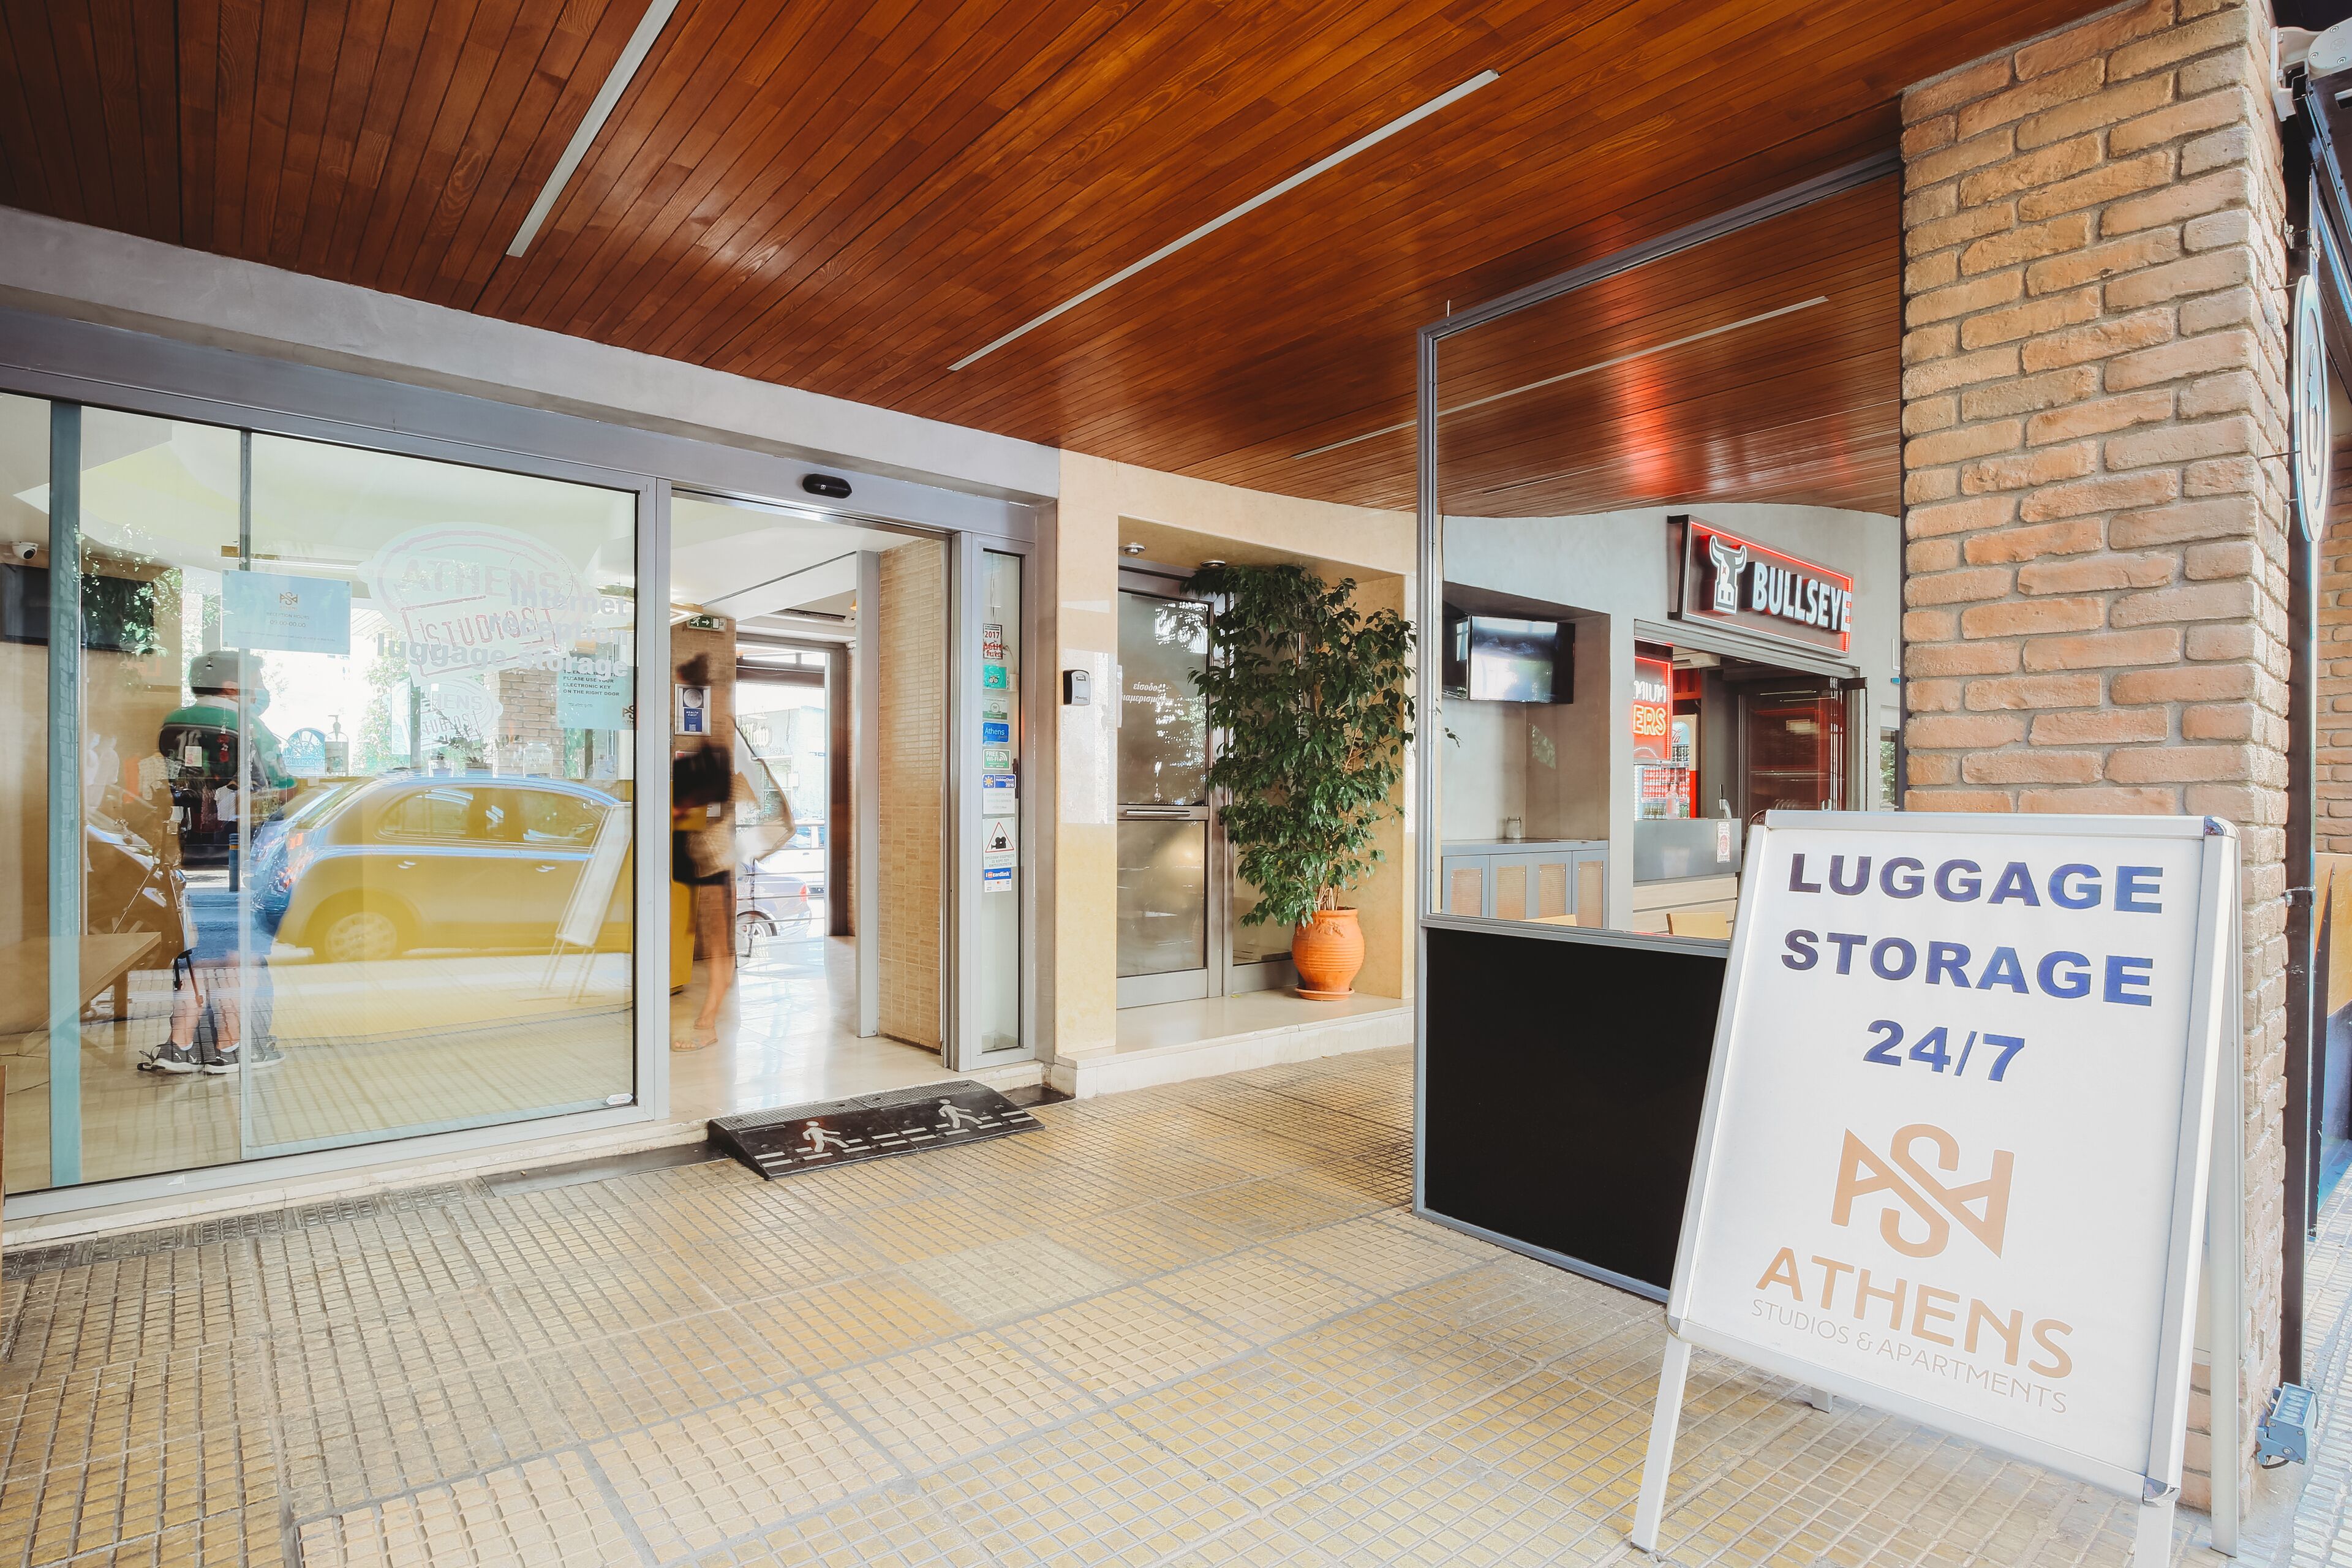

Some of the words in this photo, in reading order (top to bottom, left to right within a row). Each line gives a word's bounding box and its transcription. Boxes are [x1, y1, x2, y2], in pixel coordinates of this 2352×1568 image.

[1751, 561, 1852, 633] BULLSEYE
[377, 632, 508, 667] luggage
[518, 650, 629, 680] storage
[489, 614, 628, 646] reception
[984, 630, 1000, 639] 2017
[984, 727, 1005, 736] Athens
[1789, 853, 2163, 913] LUGGAGE
[1781, 929, 2154, 1006] STORAGE
[1863, 1019, 2026, 1082] 24/7
[1755, 1246, 2073, 1379] ATHENS
[1752, 1298, 1850, 1345] STUDIOS
[1856, 1332, 1874, 1351] &
[1875, 1338, 2067, 1414] APARTMENTS
